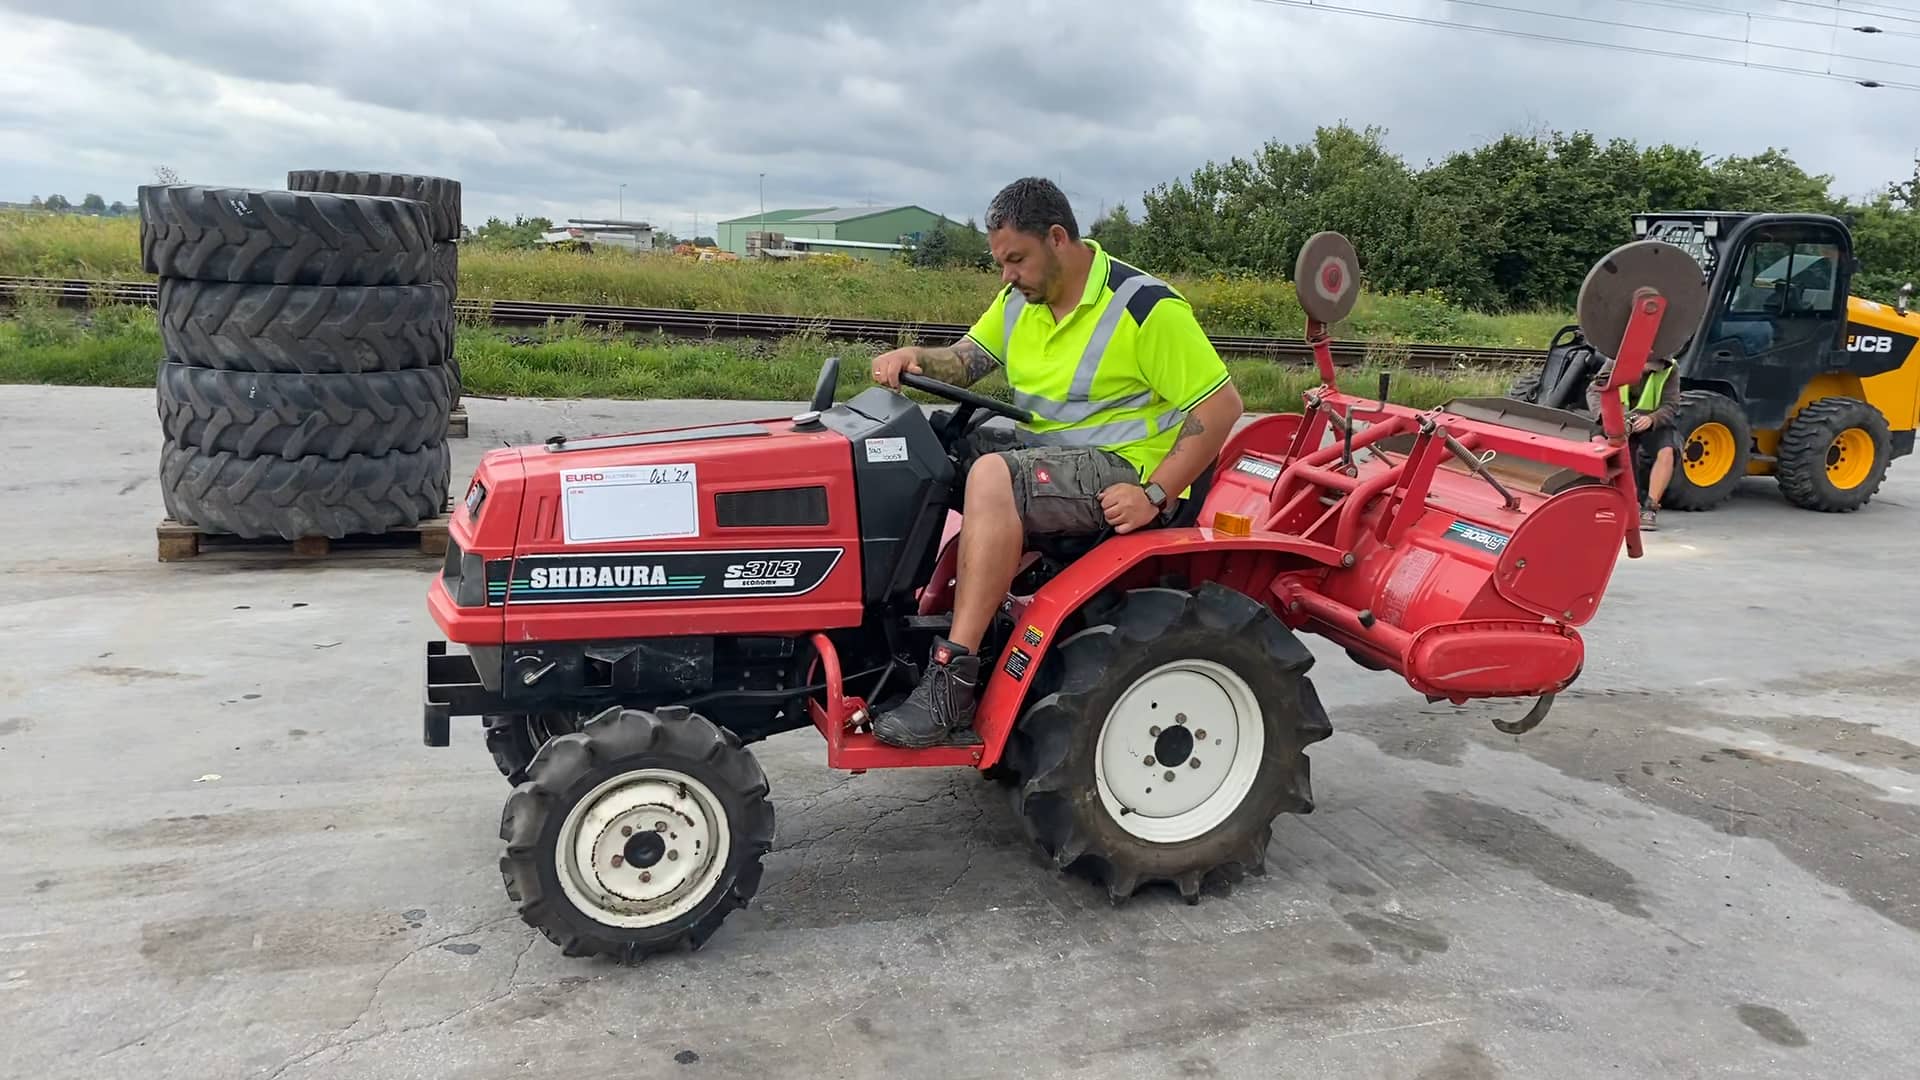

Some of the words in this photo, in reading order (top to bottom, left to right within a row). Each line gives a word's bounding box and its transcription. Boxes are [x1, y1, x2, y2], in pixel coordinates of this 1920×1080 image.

[1846, 336, 1893, 353] JCB
[565, 473, 604, 482] EURO
[530, 565, 667, 589] SHIBAURA
